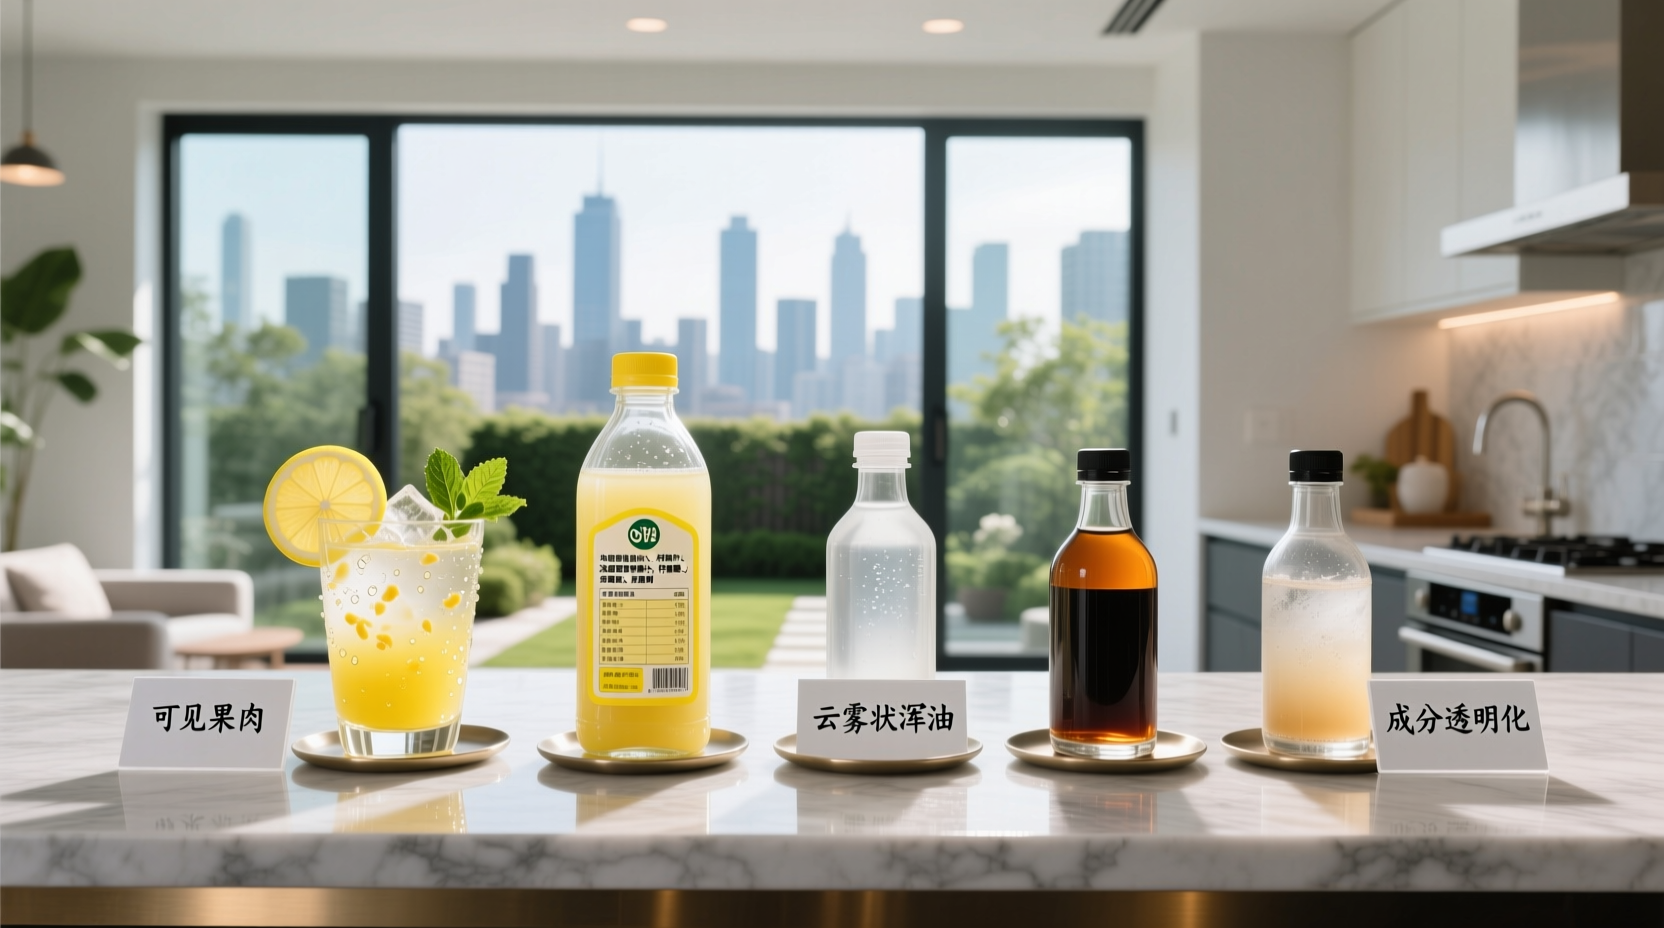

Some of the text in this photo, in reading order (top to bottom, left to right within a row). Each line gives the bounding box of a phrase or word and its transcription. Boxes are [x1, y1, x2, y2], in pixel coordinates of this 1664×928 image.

[152, 702, 264, 734] 可见果肉
[813, 702, 954, 735] 云雾状浑油
[1386, 702, 1531, 736] 成分透明化
